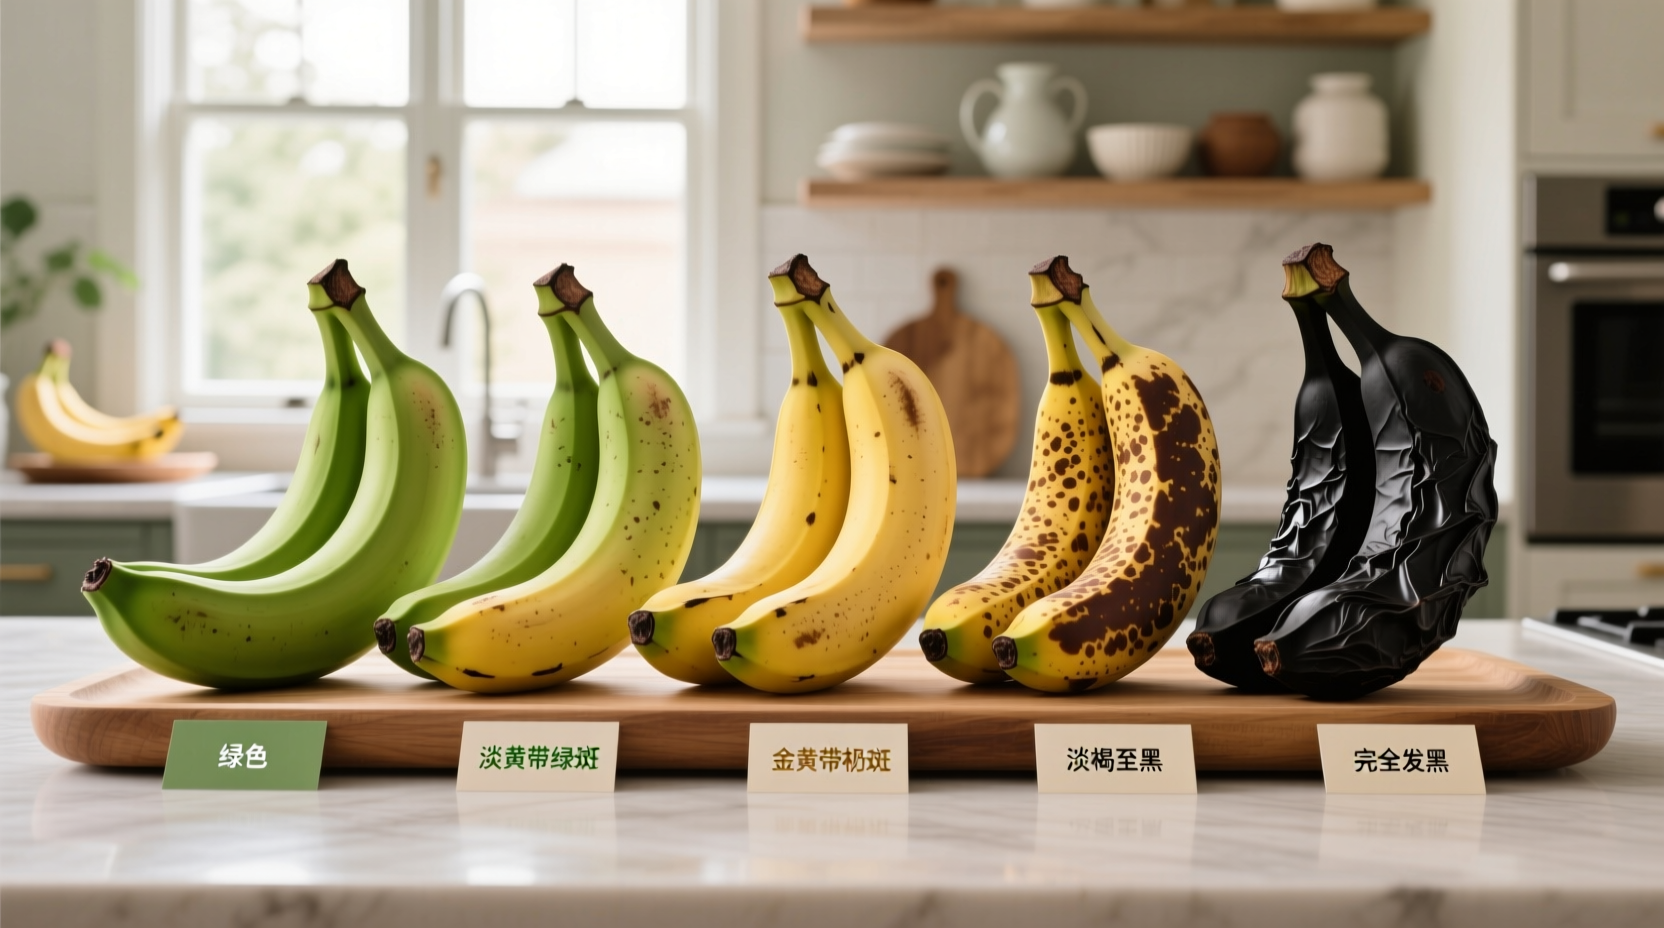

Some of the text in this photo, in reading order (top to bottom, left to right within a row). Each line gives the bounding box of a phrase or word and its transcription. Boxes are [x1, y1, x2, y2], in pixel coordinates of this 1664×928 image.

[217, 742, 268, 769] 绿色
[1354, 747, 1449, 773] 完全发黑
